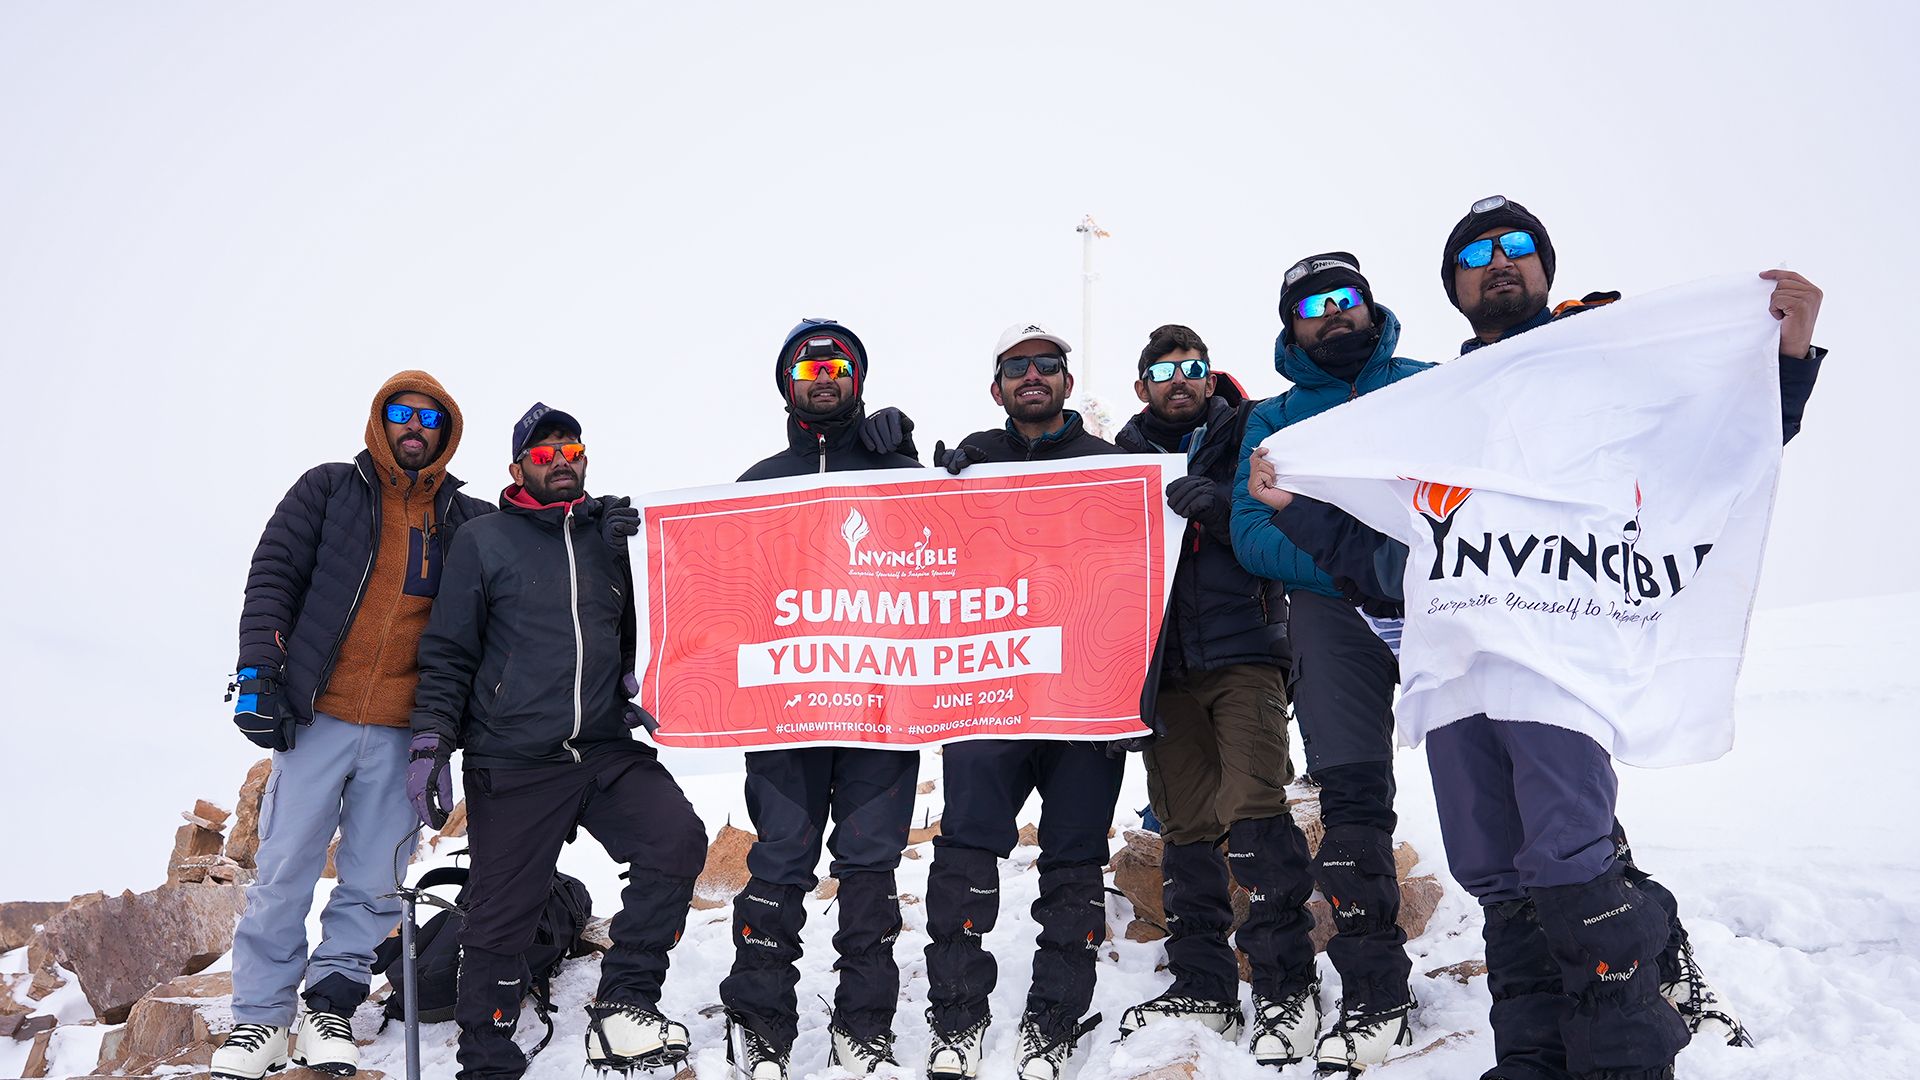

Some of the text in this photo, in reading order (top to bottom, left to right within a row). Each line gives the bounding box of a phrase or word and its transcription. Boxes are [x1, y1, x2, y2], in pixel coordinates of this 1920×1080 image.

[774, 578, 1028, 626] SUMMITED!
[1428, 594, 1498, 616] Surprise
[1505, 592, 1580, 620] Yourself
[1584, 598, 1601, 616] to
[767, 636, 1031, 677] YUNAM PEAK
[807, 688, 1014, 709] 20,050 FT JUNE 2024
[775, 715, 1022, 735] #CLIMBWITHTRICOLOR #NODRUGSCAMPAIGN
[1583, 903, 1633, 927] Mountcraft
[1193, 1006, 1214, 1014] CAMP
